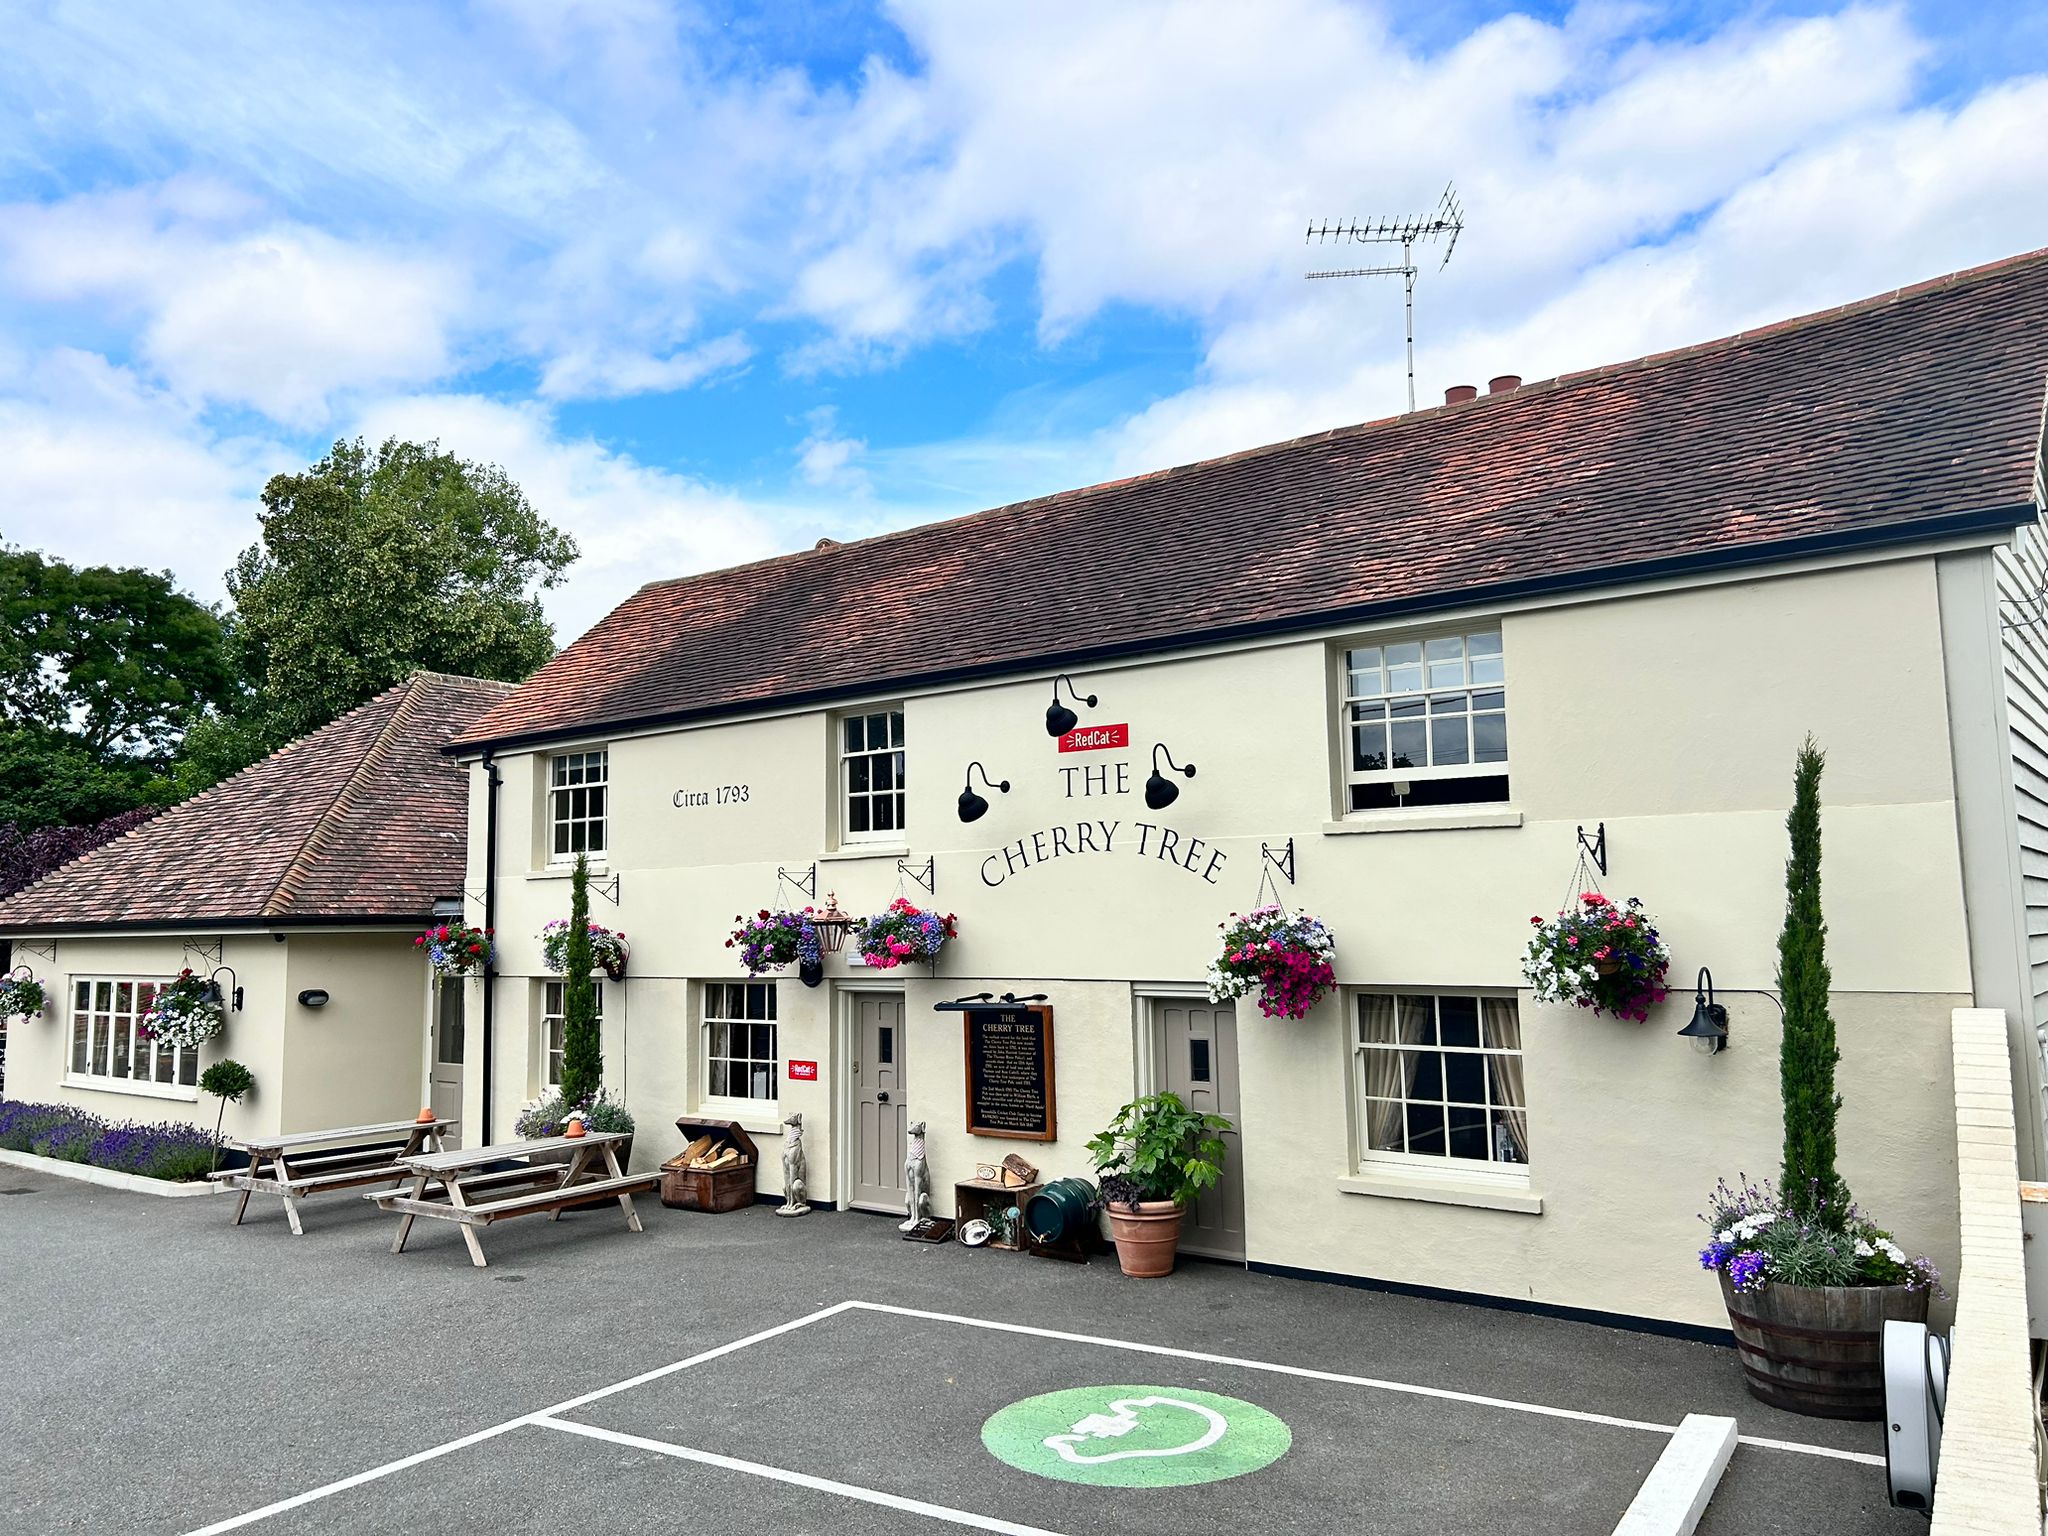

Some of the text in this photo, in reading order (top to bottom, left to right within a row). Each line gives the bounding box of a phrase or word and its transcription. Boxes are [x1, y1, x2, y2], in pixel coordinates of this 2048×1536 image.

[1075, 731, 1110, 747] RedCat
[1059, 763, 1130, 798] THE
[673, 784, 749, 808] Circa 1793
[981, 821, 1227, 887] CHERRY TREE
[1001, 1014, 1016, 1022] THE
[983, 1024, 1035, 1033] CHERRY TREE
